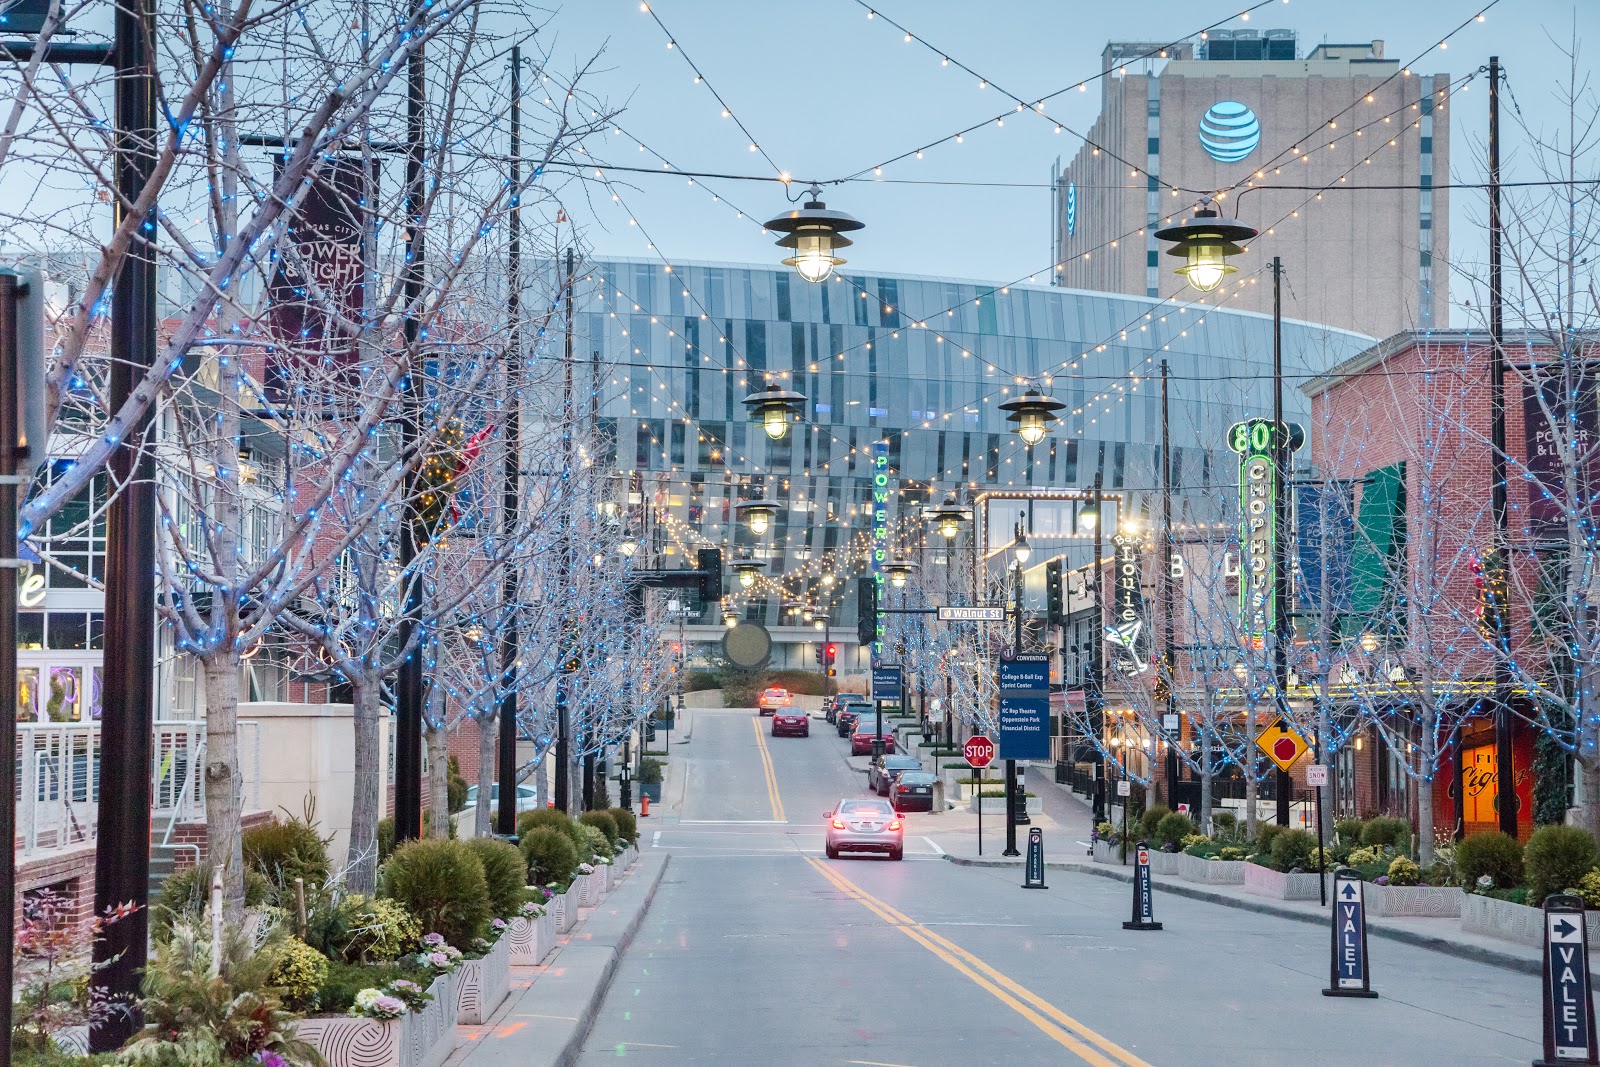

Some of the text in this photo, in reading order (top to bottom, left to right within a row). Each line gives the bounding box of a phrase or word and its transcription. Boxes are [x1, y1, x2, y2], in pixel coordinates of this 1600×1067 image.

[287, 242, 361, 260] OWER
[300, 262, 360, 280] IGHT
[1537, 445, 1547, 456] &
[1121, 546, 1136, 621] Louie
[953, 609, 999, 618] Walnut St
[966, 745, 993, 758] STOP
[1343, 905, 1356, 976] VALET
[1559, 947, 1577, 1042] VALET
